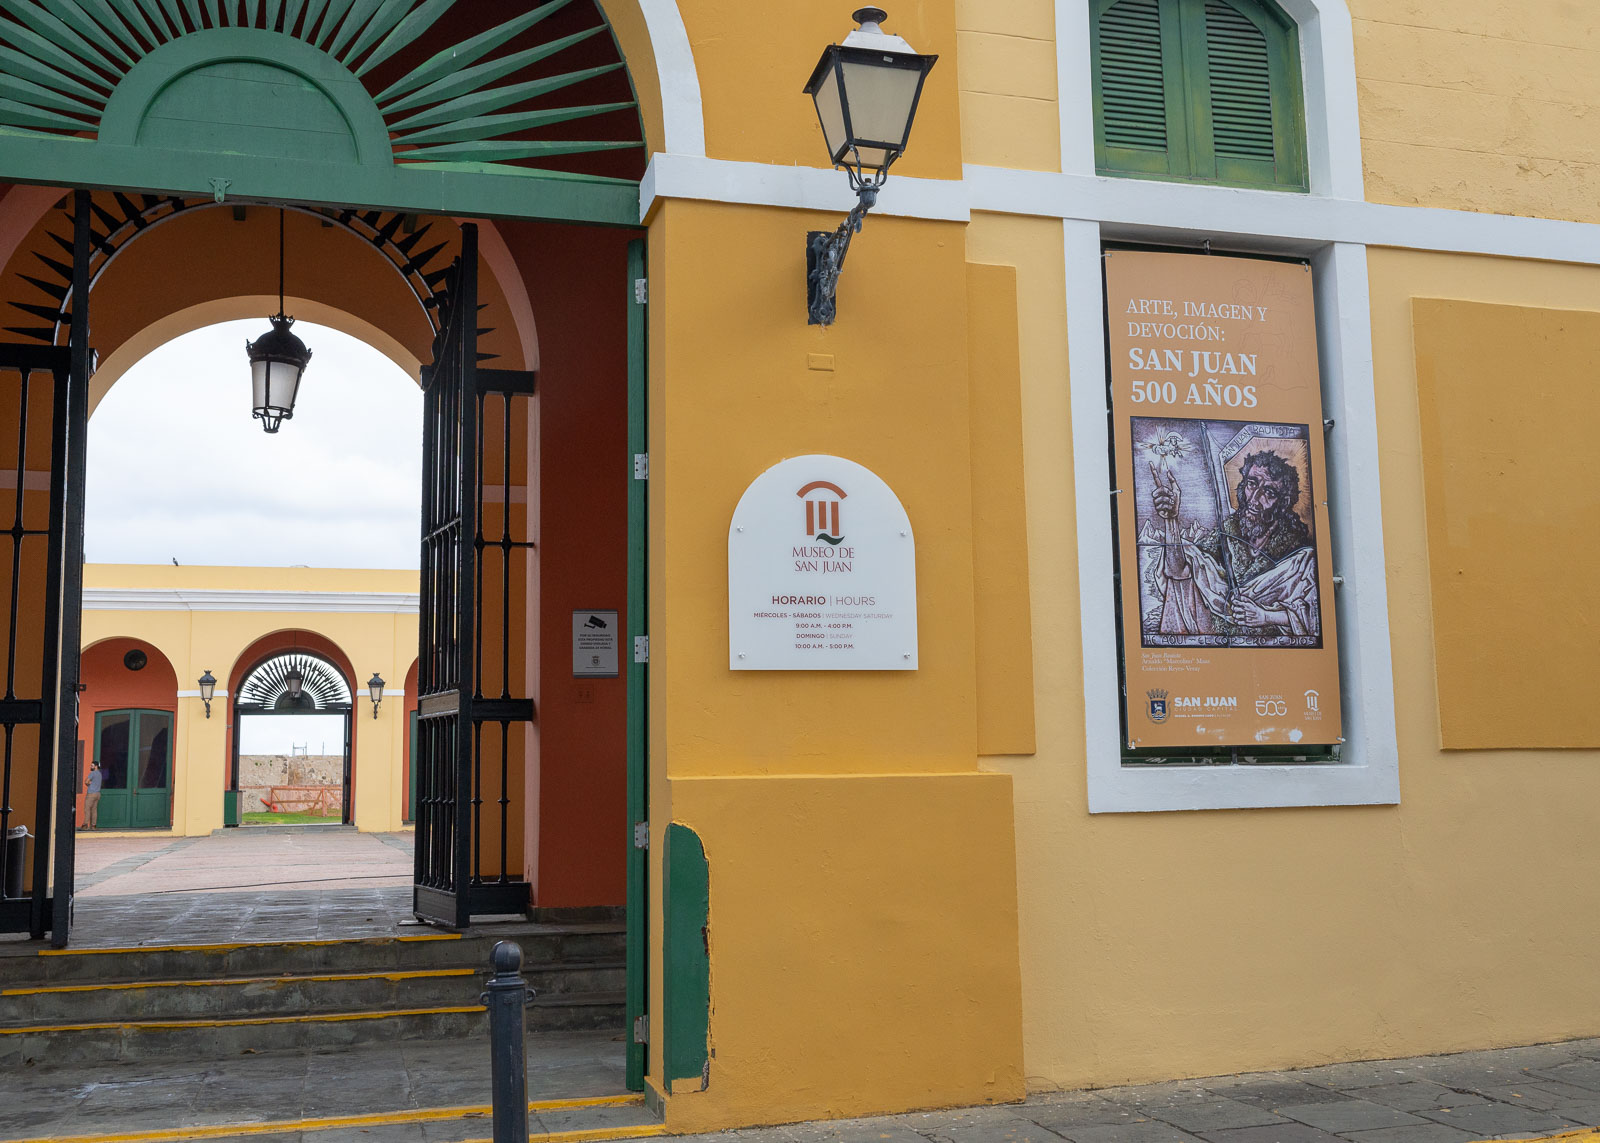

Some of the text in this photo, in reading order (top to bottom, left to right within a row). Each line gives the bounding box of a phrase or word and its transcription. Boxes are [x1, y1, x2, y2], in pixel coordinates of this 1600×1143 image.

[1126, 298, 1268, 322] ARTE, IMAGEN Y
[1127, 321, 1225, 341] DEVOCIÓN:
[1128, 347, 1257, 377] SAN JUAN
[1130, 378, 1258, 408] 500 AÑOS
[792, 546, 855, 559] MUSEO DE
[794, 560, 852, 574] SAN JUAN
[771, 595, 876, 606] HORARIO HOURS
[753, 611, 788, 619] MIÉRCOLES
[1174, 696, 1238, 707] SAN JUAN
